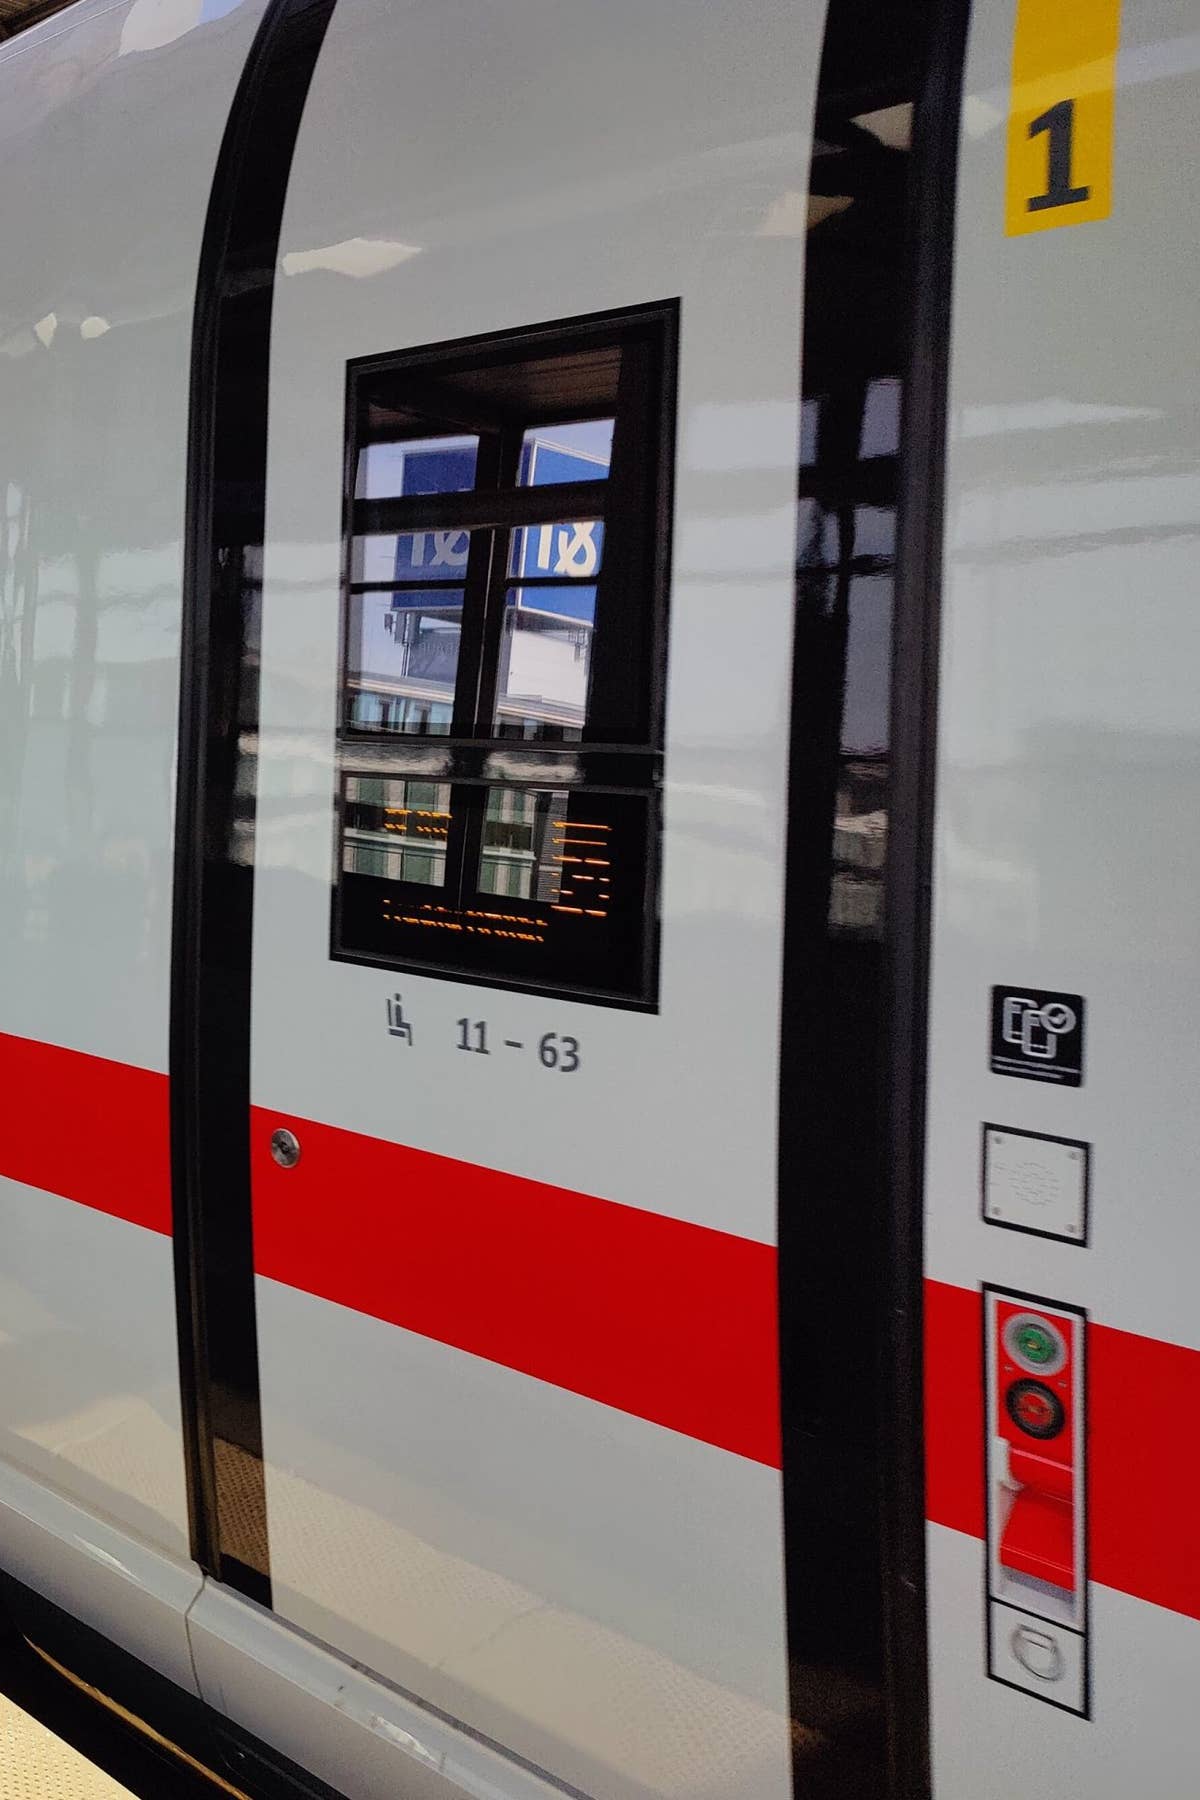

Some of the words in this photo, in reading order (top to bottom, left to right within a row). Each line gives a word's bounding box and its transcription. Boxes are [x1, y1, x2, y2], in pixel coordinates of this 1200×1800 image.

[1026, 98, 1090, 213] 1
[456, 1018, 490, 1054] 11
[540, 1032, 579, 1072] 63
